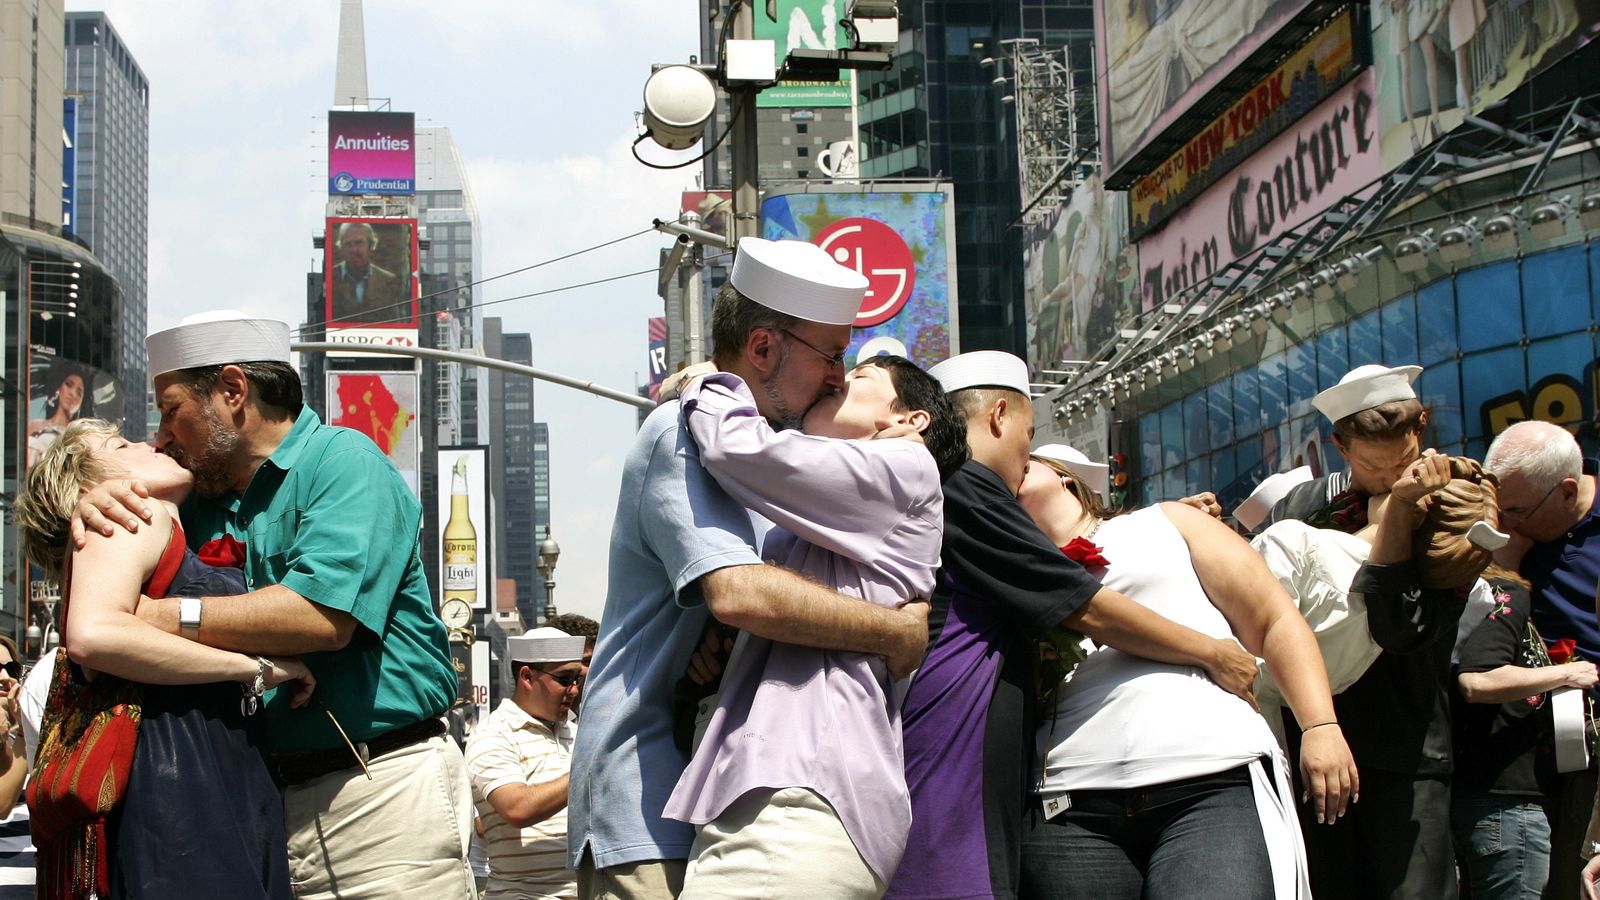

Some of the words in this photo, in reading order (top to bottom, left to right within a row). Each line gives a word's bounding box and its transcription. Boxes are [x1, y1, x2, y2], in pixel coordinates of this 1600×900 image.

[1173, 153, 1184, 173] TO
[1185, 118, 1225, 177] NEW
[1228, 69, 1287, 142] YORK
[334, 132, 409, 151] Annuities
[1228, 89, 1375, 258] Couture
[356, 179, 410, 190] Prudential
[444, 542, 475, 553] Corona
[447, 566, 474, 580] Light
